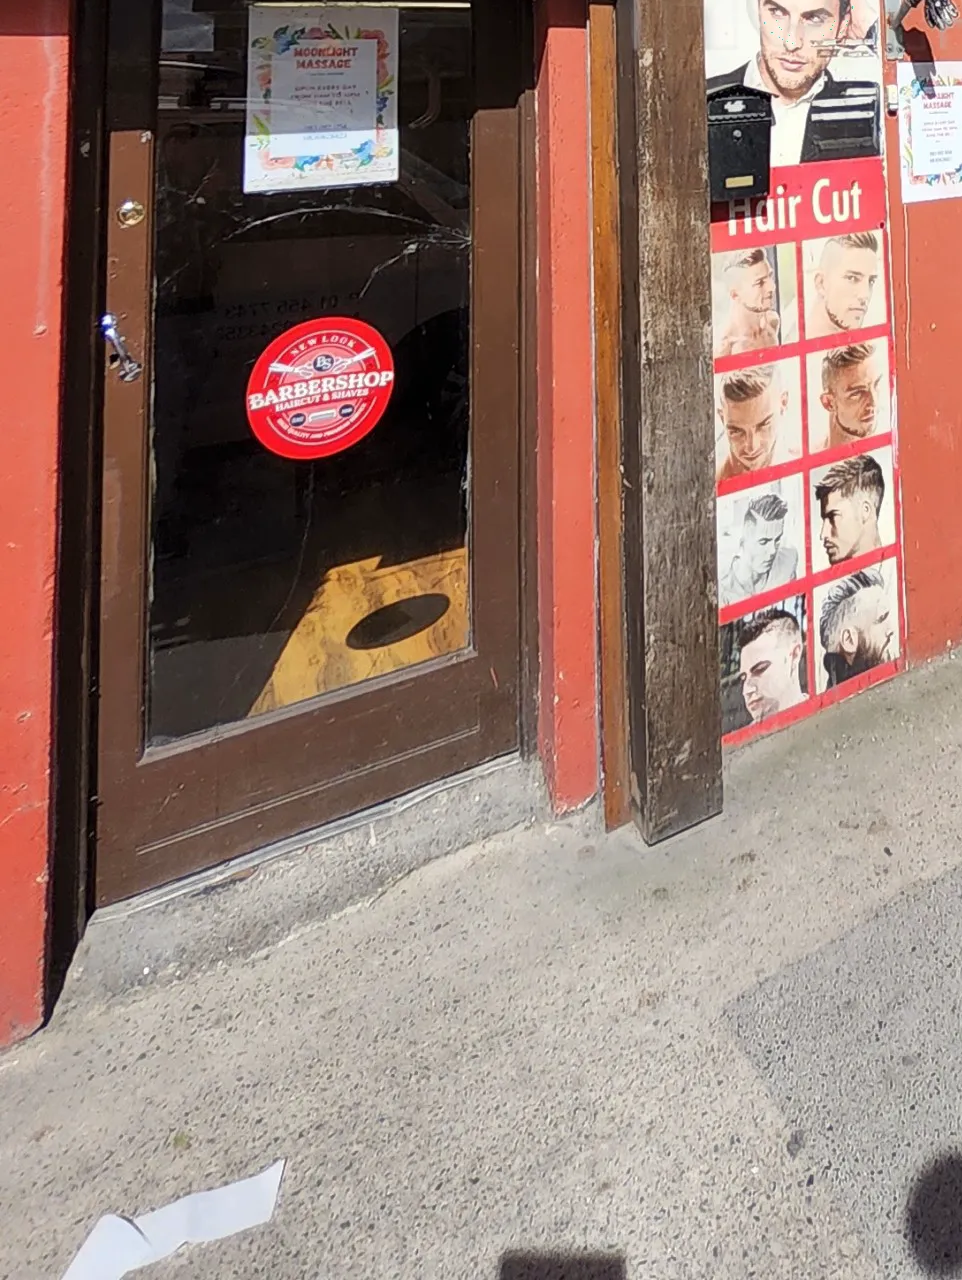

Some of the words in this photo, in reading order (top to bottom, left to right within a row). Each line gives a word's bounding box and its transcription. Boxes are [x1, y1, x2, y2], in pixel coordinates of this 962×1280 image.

[293, 47, 359, 58] MOONLIGHT
[296, 59, 352, 69] MASSAGE
[728, 184, 802, 236] Hair
[812, 178, 862, 224] Cut
[290, 337, 317, 356] NEW
[322, 334, 357, 349] LOOK
[248, 370, 394, 411] BARBERSHOP
[275, 394, 321, 412] HAIRCUT
[322, 392, 330, 402] &
[331, 387, 369, 400] SHAVES
